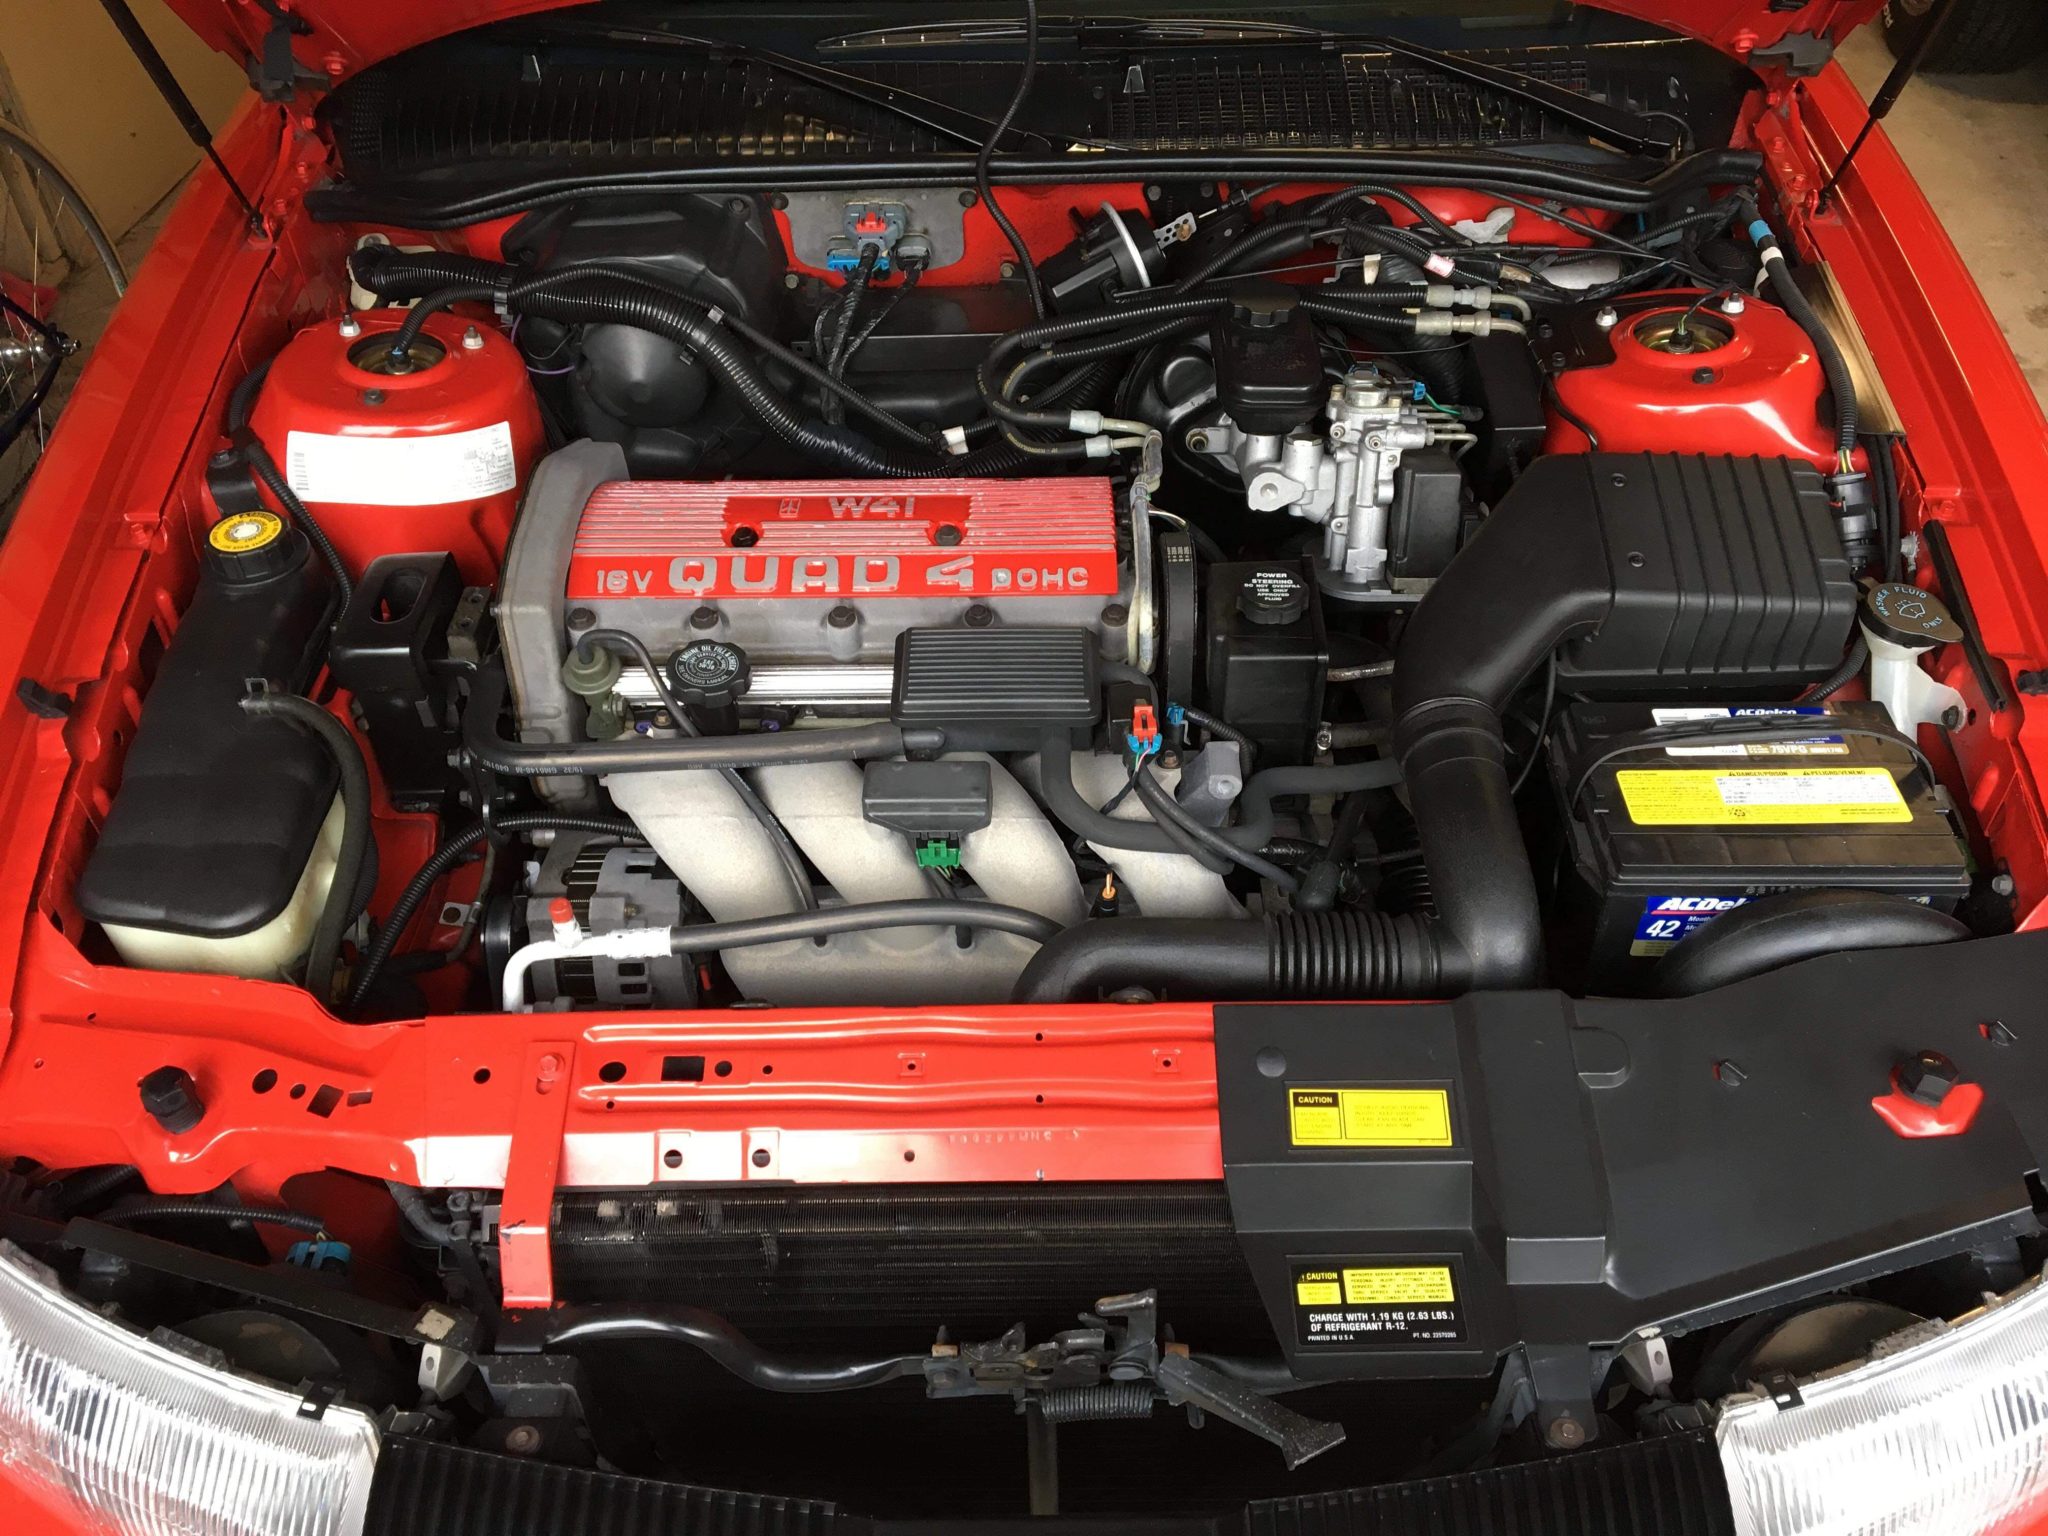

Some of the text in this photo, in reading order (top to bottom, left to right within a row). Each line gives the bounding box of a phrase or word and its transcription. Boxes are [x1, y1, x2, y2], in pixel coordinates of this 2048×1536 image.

[596, 555, 1089, 596] 16V QUAD 4 DOHC
[1875, 586, 1927, 617] WASHER FLUID
[1922, 616, 1943, 629] ONLY
[679, 646, 699, 662] ENGINE
[1657, 897, 1751, 911] ACDel
[1645, 919, 1682, 938] 42
[1298, 1096, 1333, 1104] CAUTION
[1306, 1272, 1338, 1281] CAUTION
[1309, 1311, 1455, 1323] CHARGE WITH 1.19 KG (2.63 LBS.)
[1310, 1321, 1409, 1332] OF REFRIGERANT R-12.
